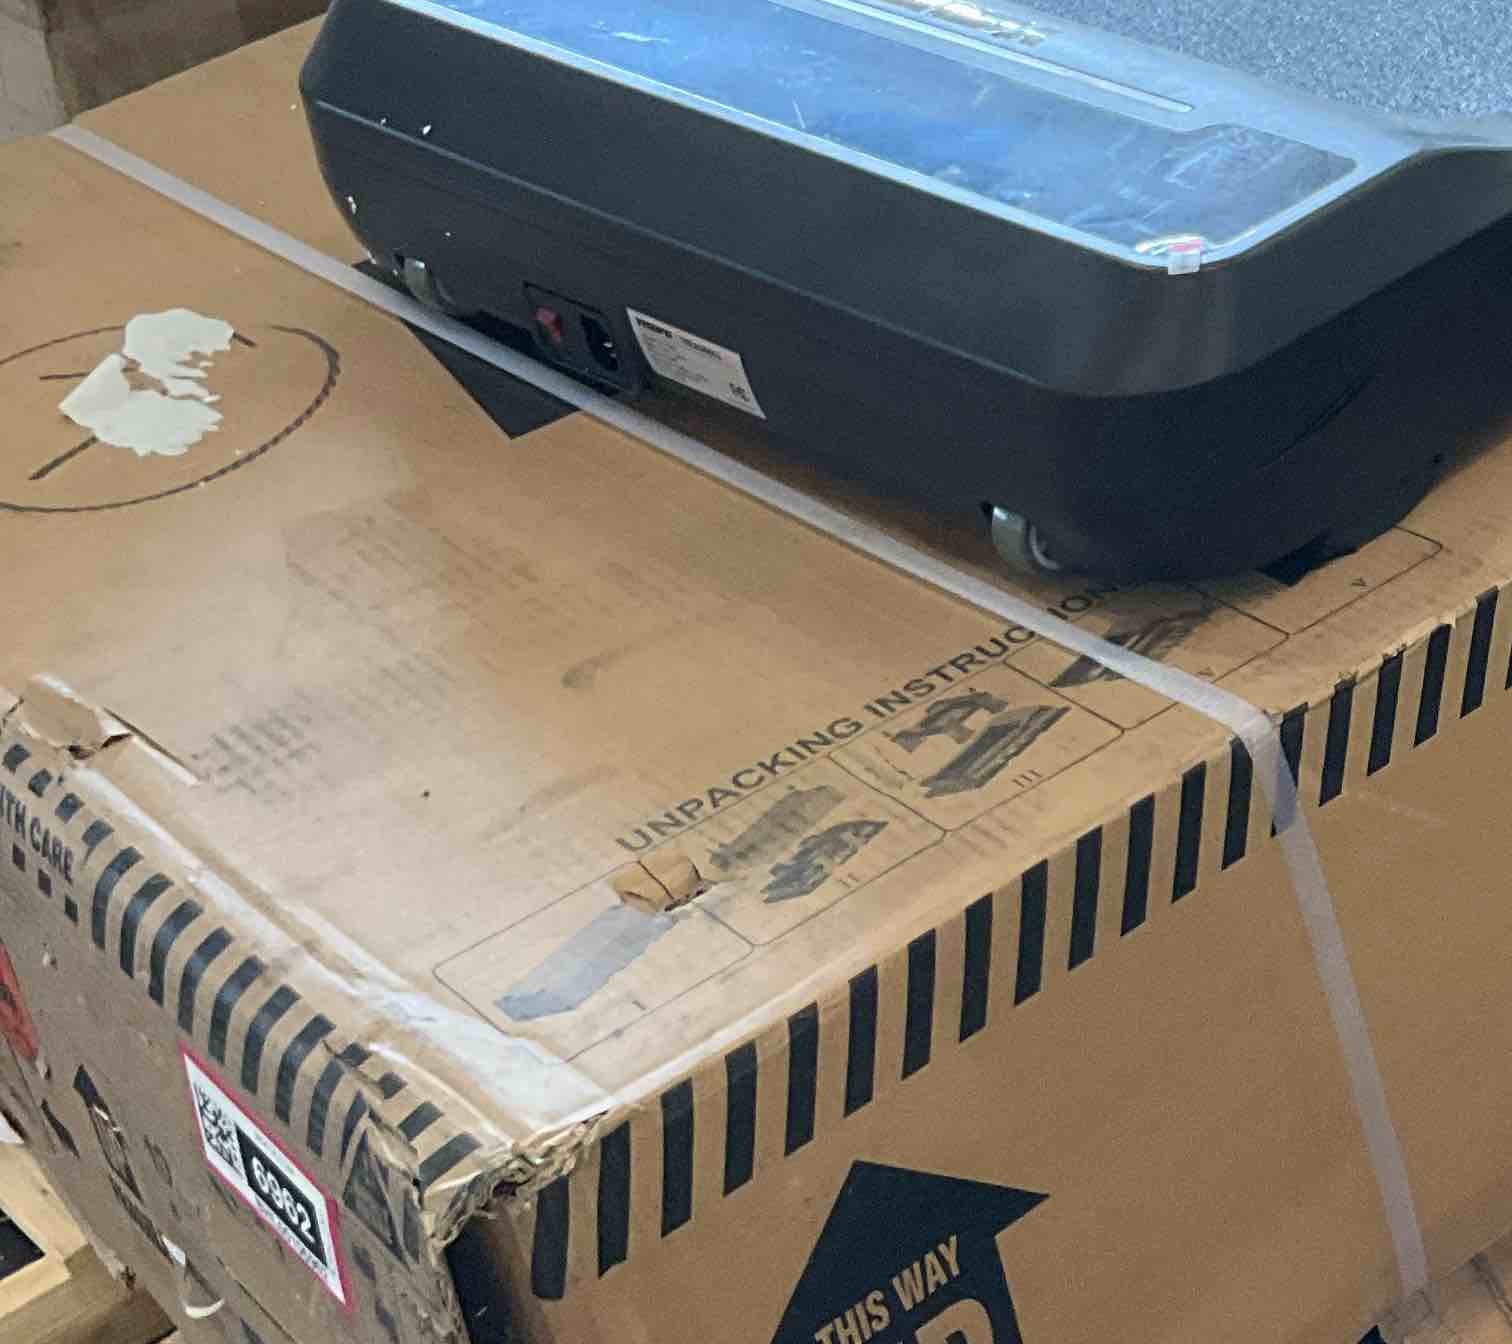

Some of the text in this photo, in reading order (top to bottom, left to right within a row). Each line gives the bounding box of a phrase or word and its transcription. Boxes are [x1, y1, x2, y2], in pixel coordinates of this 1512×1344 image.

[614, 586, 1122, 854] UNPACKING INSTRUCION
[1010, 768, 1044, 790] III
[30, 815, 74, 886] CARE
[890, 1233, 961, 1312] WAY
